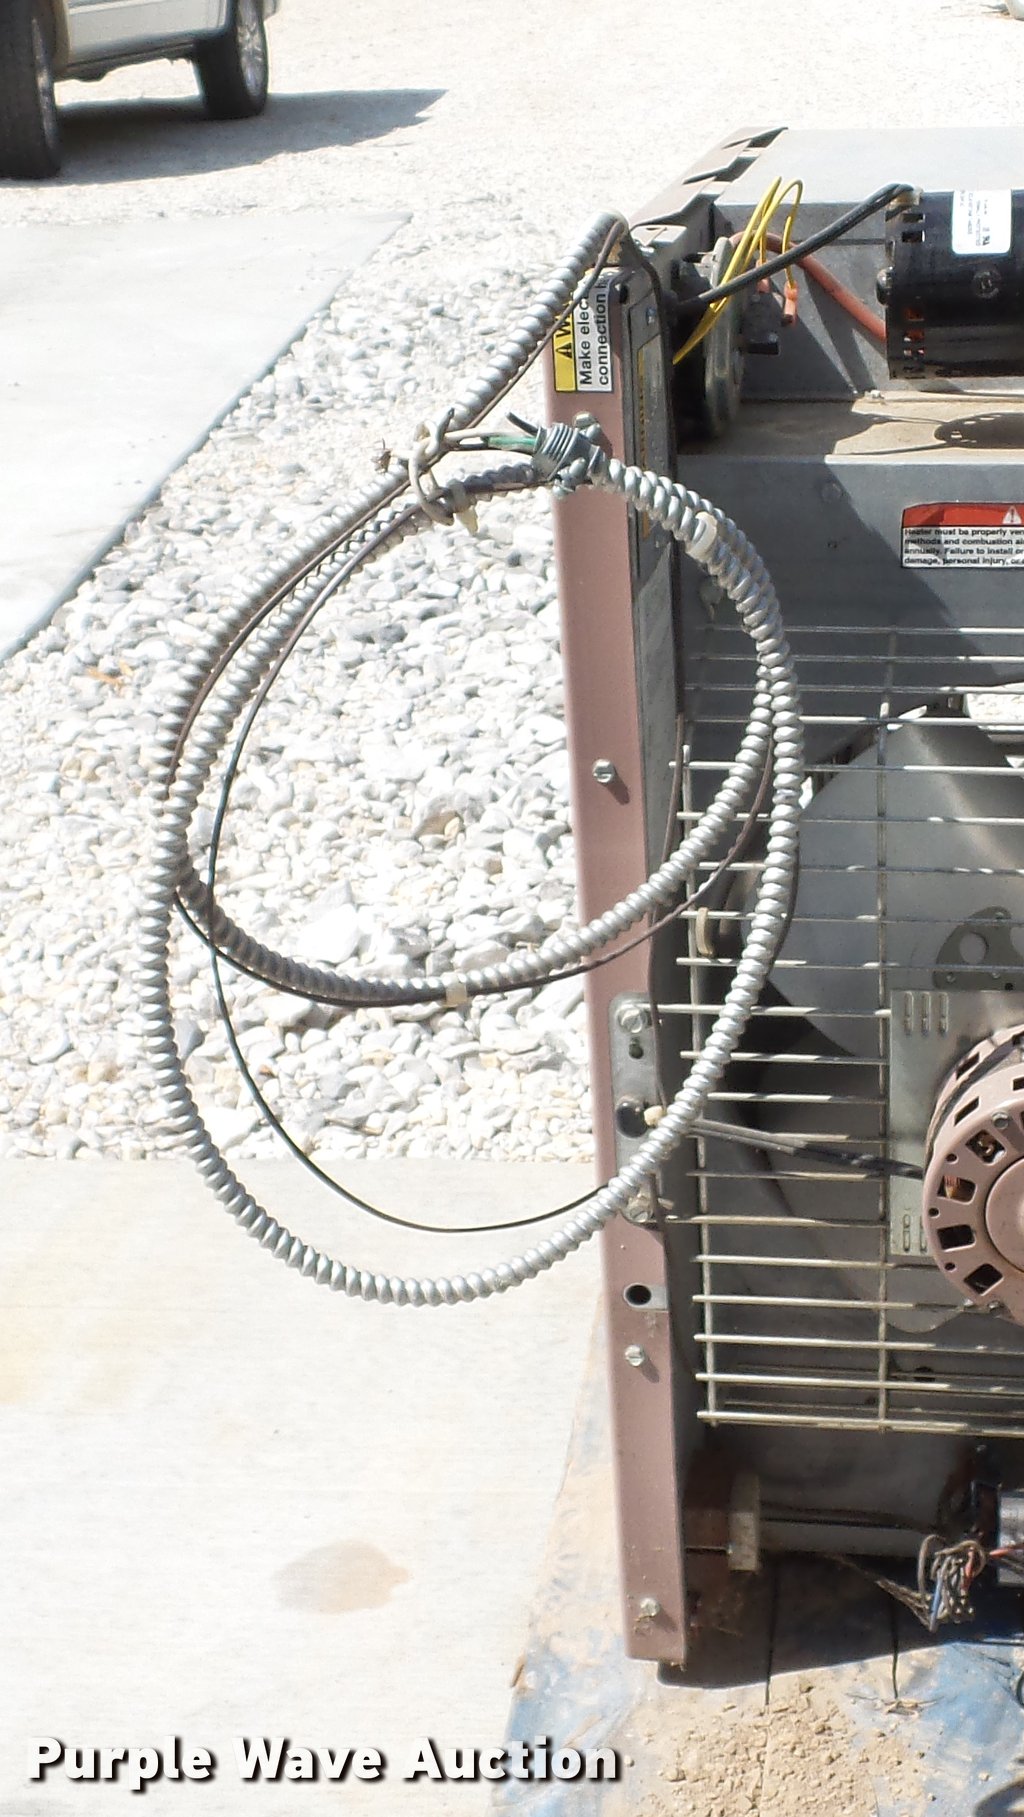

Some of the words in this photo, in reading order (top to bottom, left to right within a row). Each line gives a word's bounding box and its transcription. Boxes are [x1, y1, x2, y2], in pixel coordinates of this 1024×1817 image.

[593, 293, 609, 385] connection
[579, 341, 593, 385] Make
[935, 528, 956, 536] must
[958, 528, 969, 536] be
[971, 528, 1008, 538] properly
[944, 547, 974, 555] Failure
[976, 547, 985, 555] to
[987, 547, 1013, 555] install
[1015, 547, 1024, 555] or
[942, 557, 980, 566] personal
